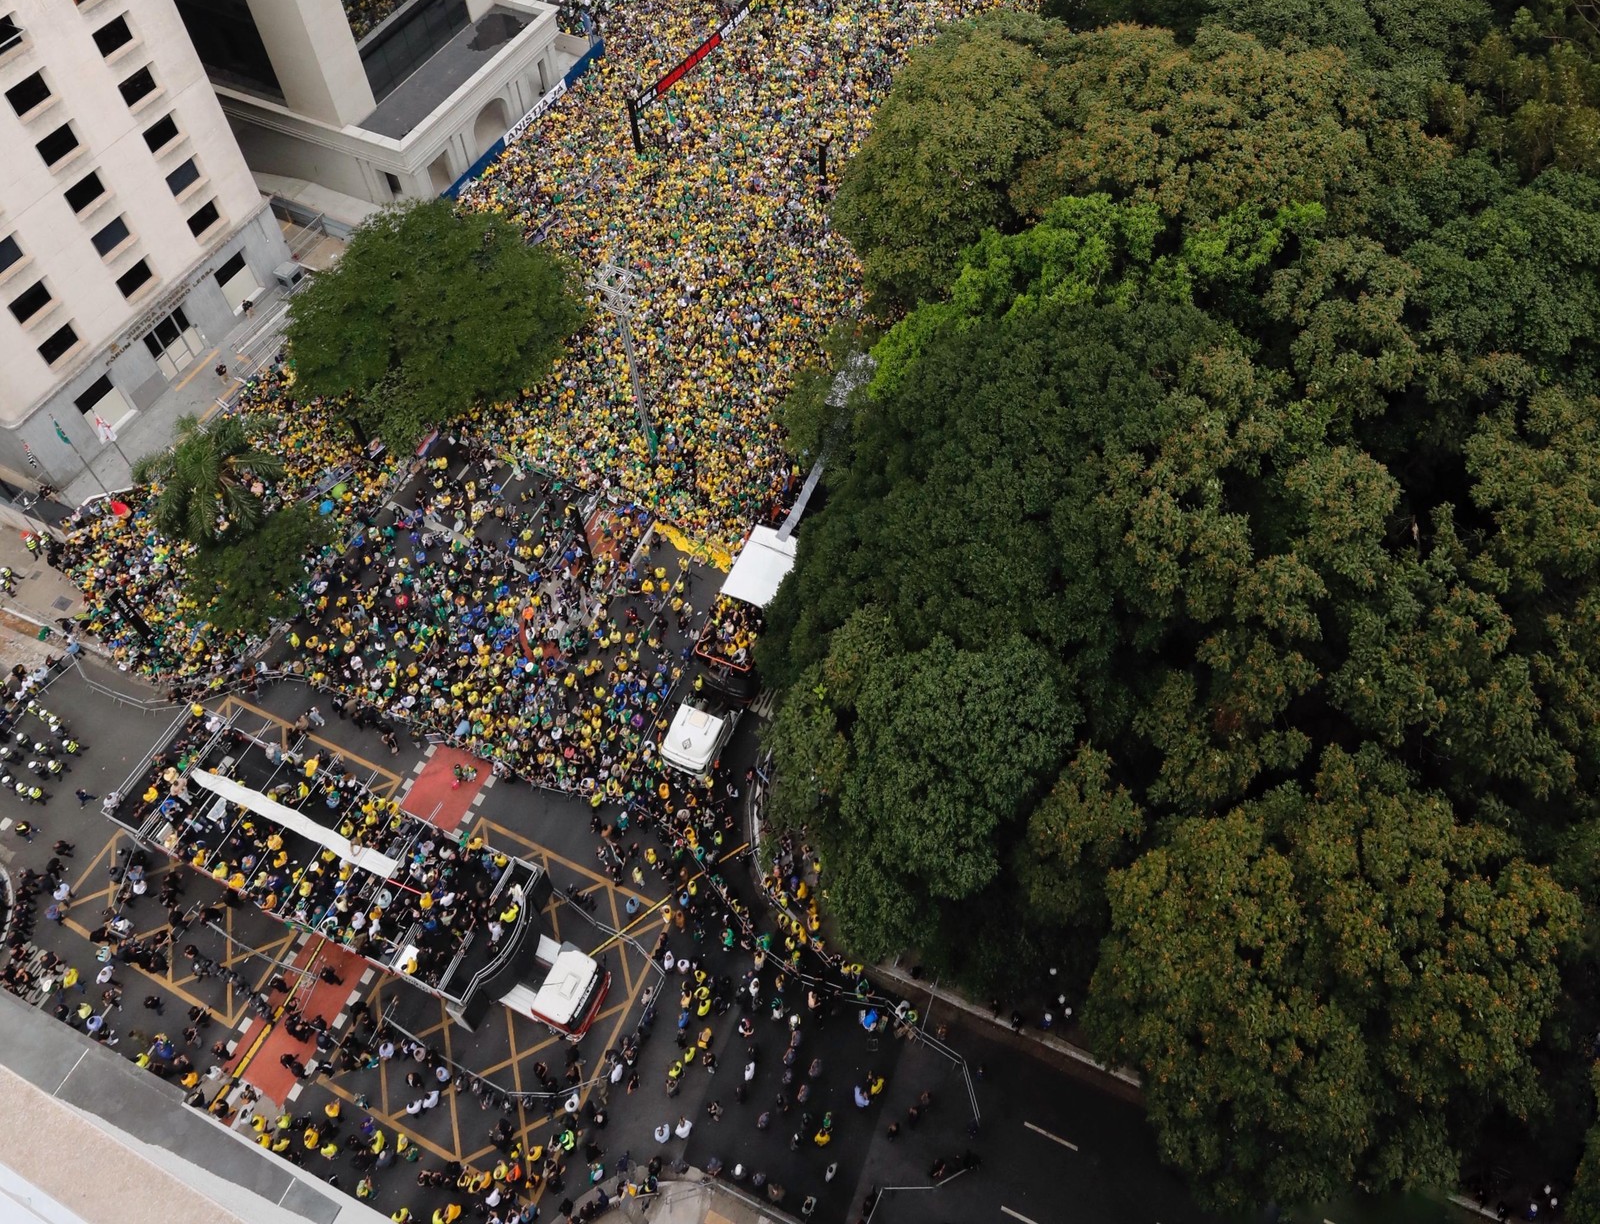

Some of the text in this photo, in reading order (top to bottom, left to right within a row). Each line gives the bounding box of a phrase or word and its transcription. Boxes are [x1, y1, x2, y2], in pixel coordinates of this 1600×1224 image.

[508, 99, 549, 143] ANISTIA
[133, 311, 166, 342] MINISTRO
[168, 288, 191, 309] PEDRO
